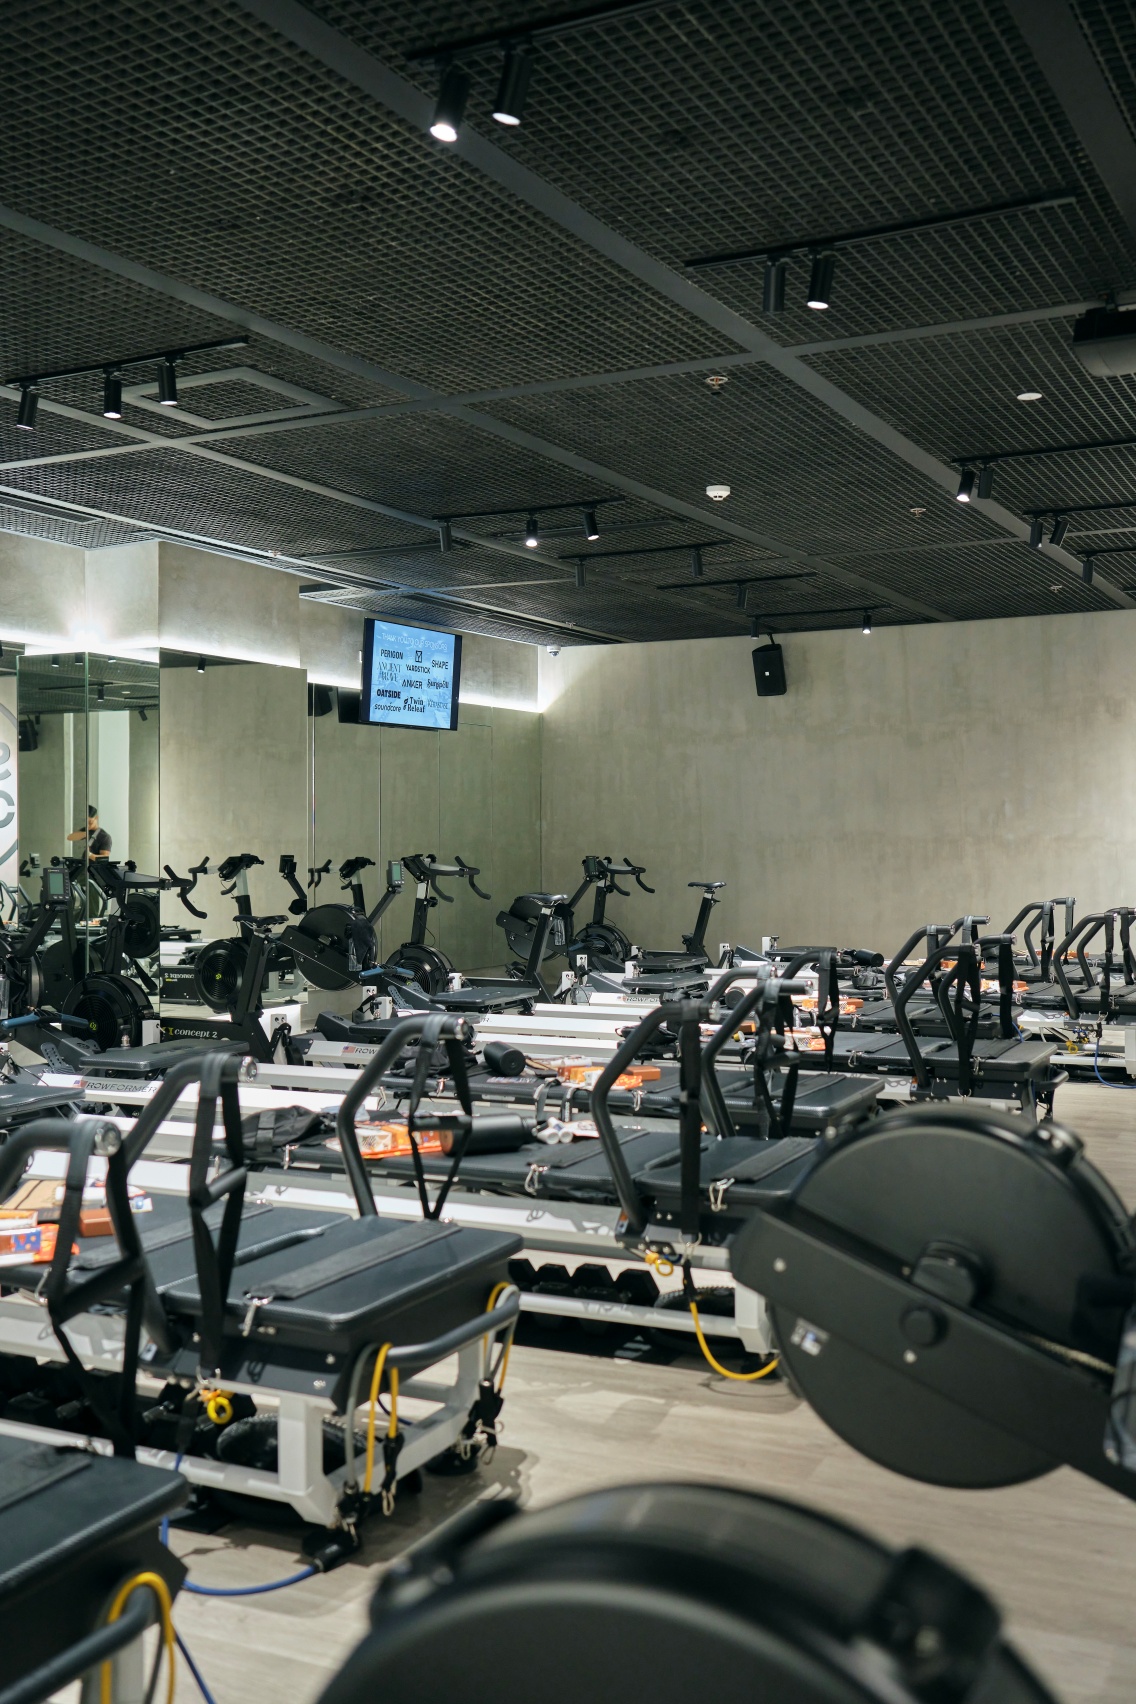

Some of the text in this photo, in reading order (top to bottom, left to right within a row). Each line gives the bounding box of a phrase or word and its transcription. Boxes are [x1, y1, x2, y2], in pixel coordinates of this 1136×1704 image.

[381, 649, 403, 660] PERIGON
[406, 664, 431, 674] YARDSTICK
[432, 660, 449, 670] SHAPE
[402, 679, 423, 689] ANKER
[377, 689, 401, 699] OATSIDE
[410, 697, 424, 705] Twin
[374, 702, 401, 712] soundcore
[407, 704, 426, 713] Releaf
[174, 1027, 210, 1039] concept
[86, 1081, 157, 1093] ROWFORMER
